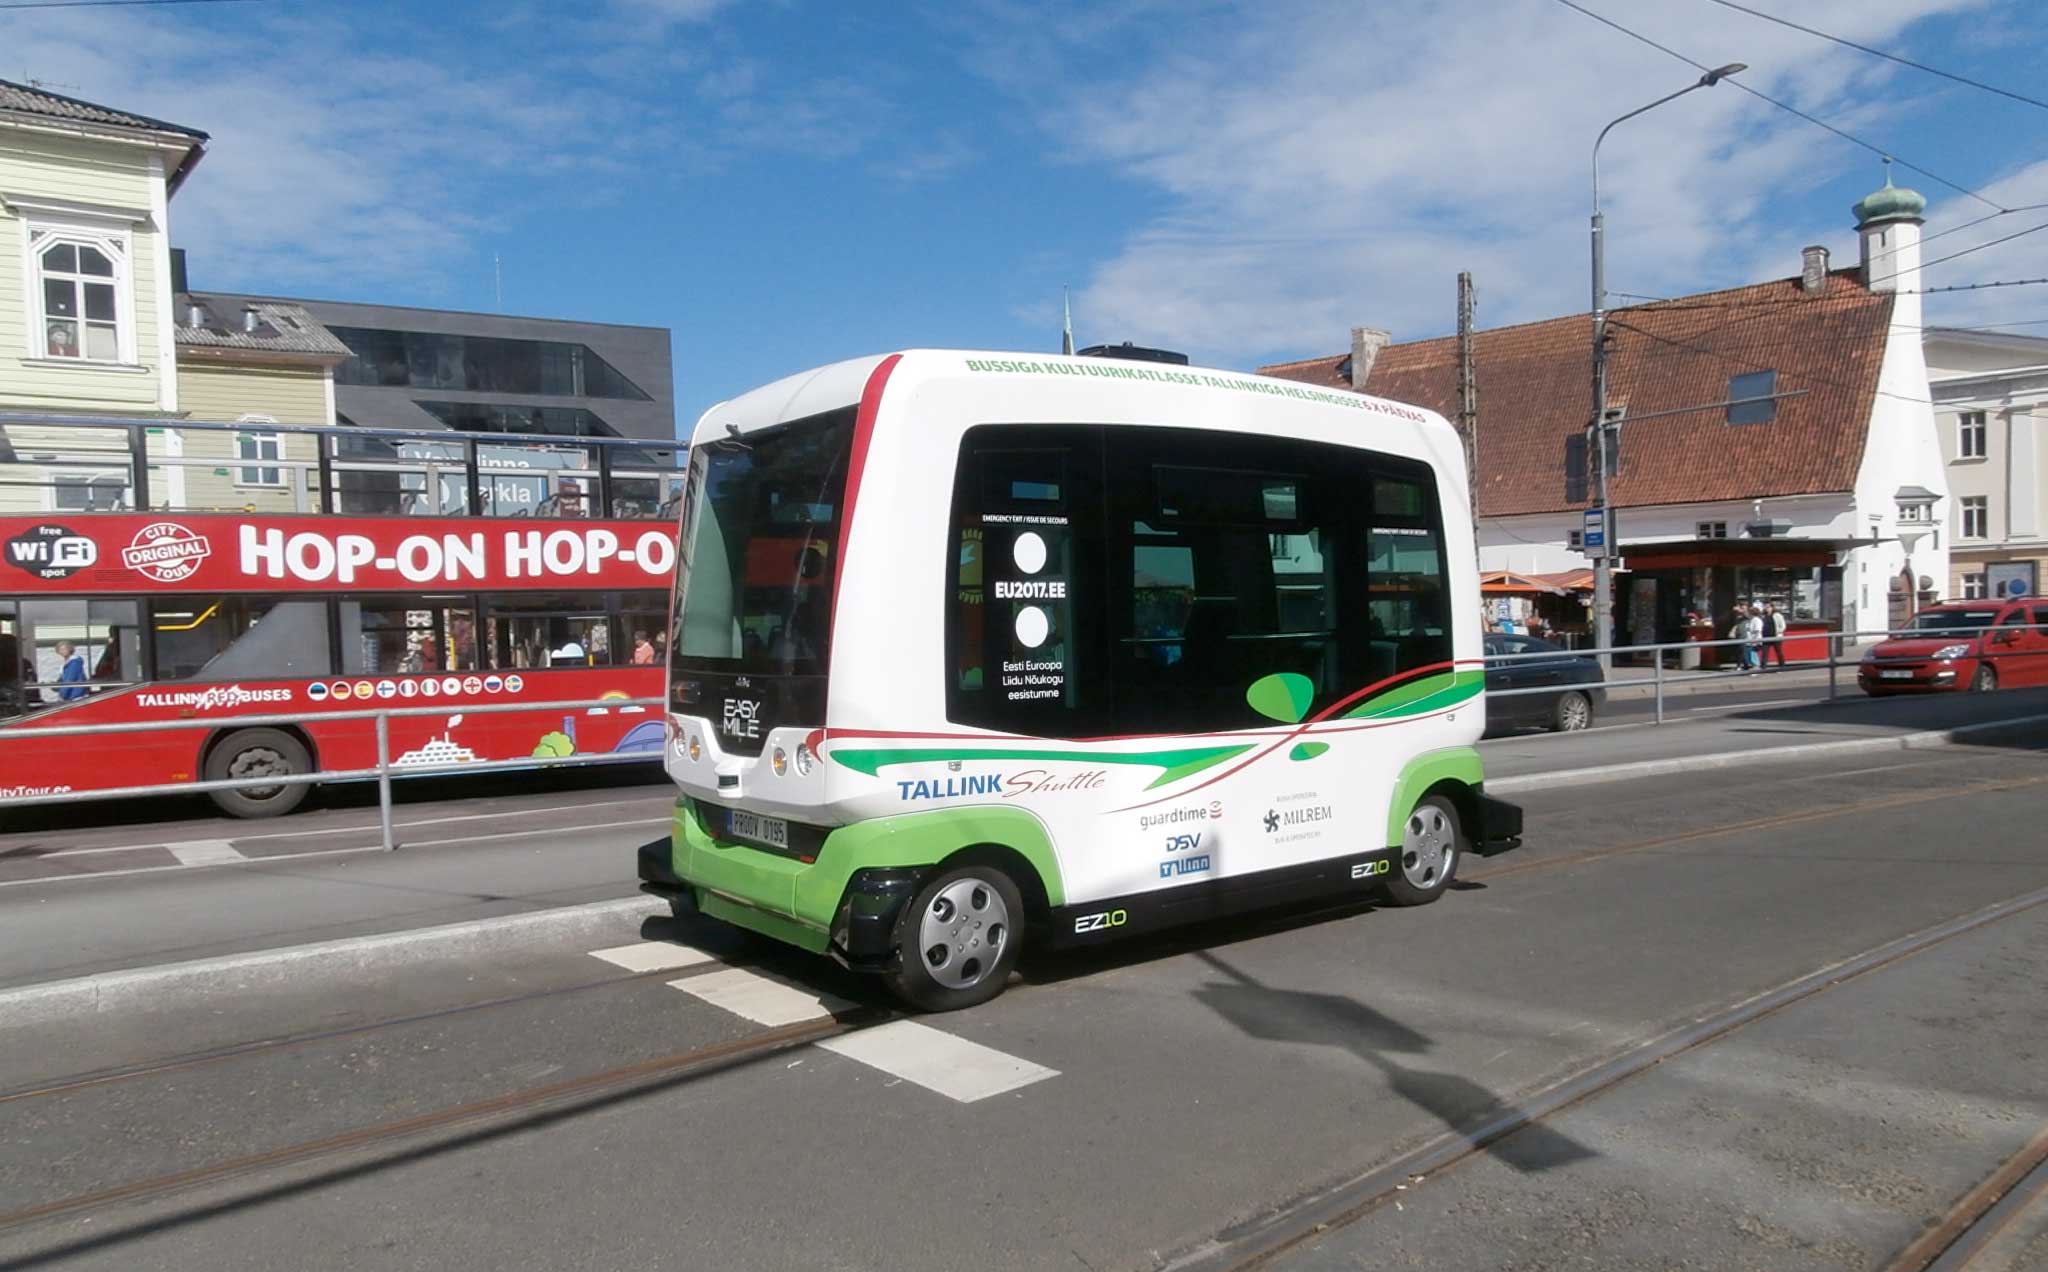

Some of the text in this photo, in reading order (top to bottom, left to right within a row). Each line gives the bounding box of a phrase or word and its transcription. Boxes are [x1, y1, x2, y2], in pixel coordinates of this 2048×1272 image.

[965, 359, 1044, 374] BUSSIGA
[1044, 362, 1203, 386] KULTUURIKATLASSE
[1205, 376, 1284, 396] TALLINKIGA
[1284, 386, 1363, 409] HELSINGISSE
[39, 526, 62, 536] free
[145, 525, 177, 540] CITY
[128, 540, 205, 564] ORIGINAL
[239, 524, 677, 583] HOP-ON HOP-O
[40, 568, 66, 577] spot
[154, 566, 192, 579] TOUR
[995, 581, 1066, 599] EU2017.EE
[1003, 660, 1062, 673] Eesti Euroopa
[1003, 673, 1064, 687] Liidu Nõukogu
[136, 692, 202, 707] TALLINN
[241, 688, 292, 702] BUSES
[1008, 689, 1059, 700] eesistumine
[723, 699, 760, 719] EASY
[723, 717, 760, 738] MILE
[897, 769, 1107, 801] TALLINK Shuttle
[1140, 805, 1207, 830] guardtime
[1283, 805, 1332, 825] MILREM
[1166, 832, 1201, 852] DSV
[1351, 859, 1389, 879] EZ10
[1075, 909, 1127, 934] EZ10
